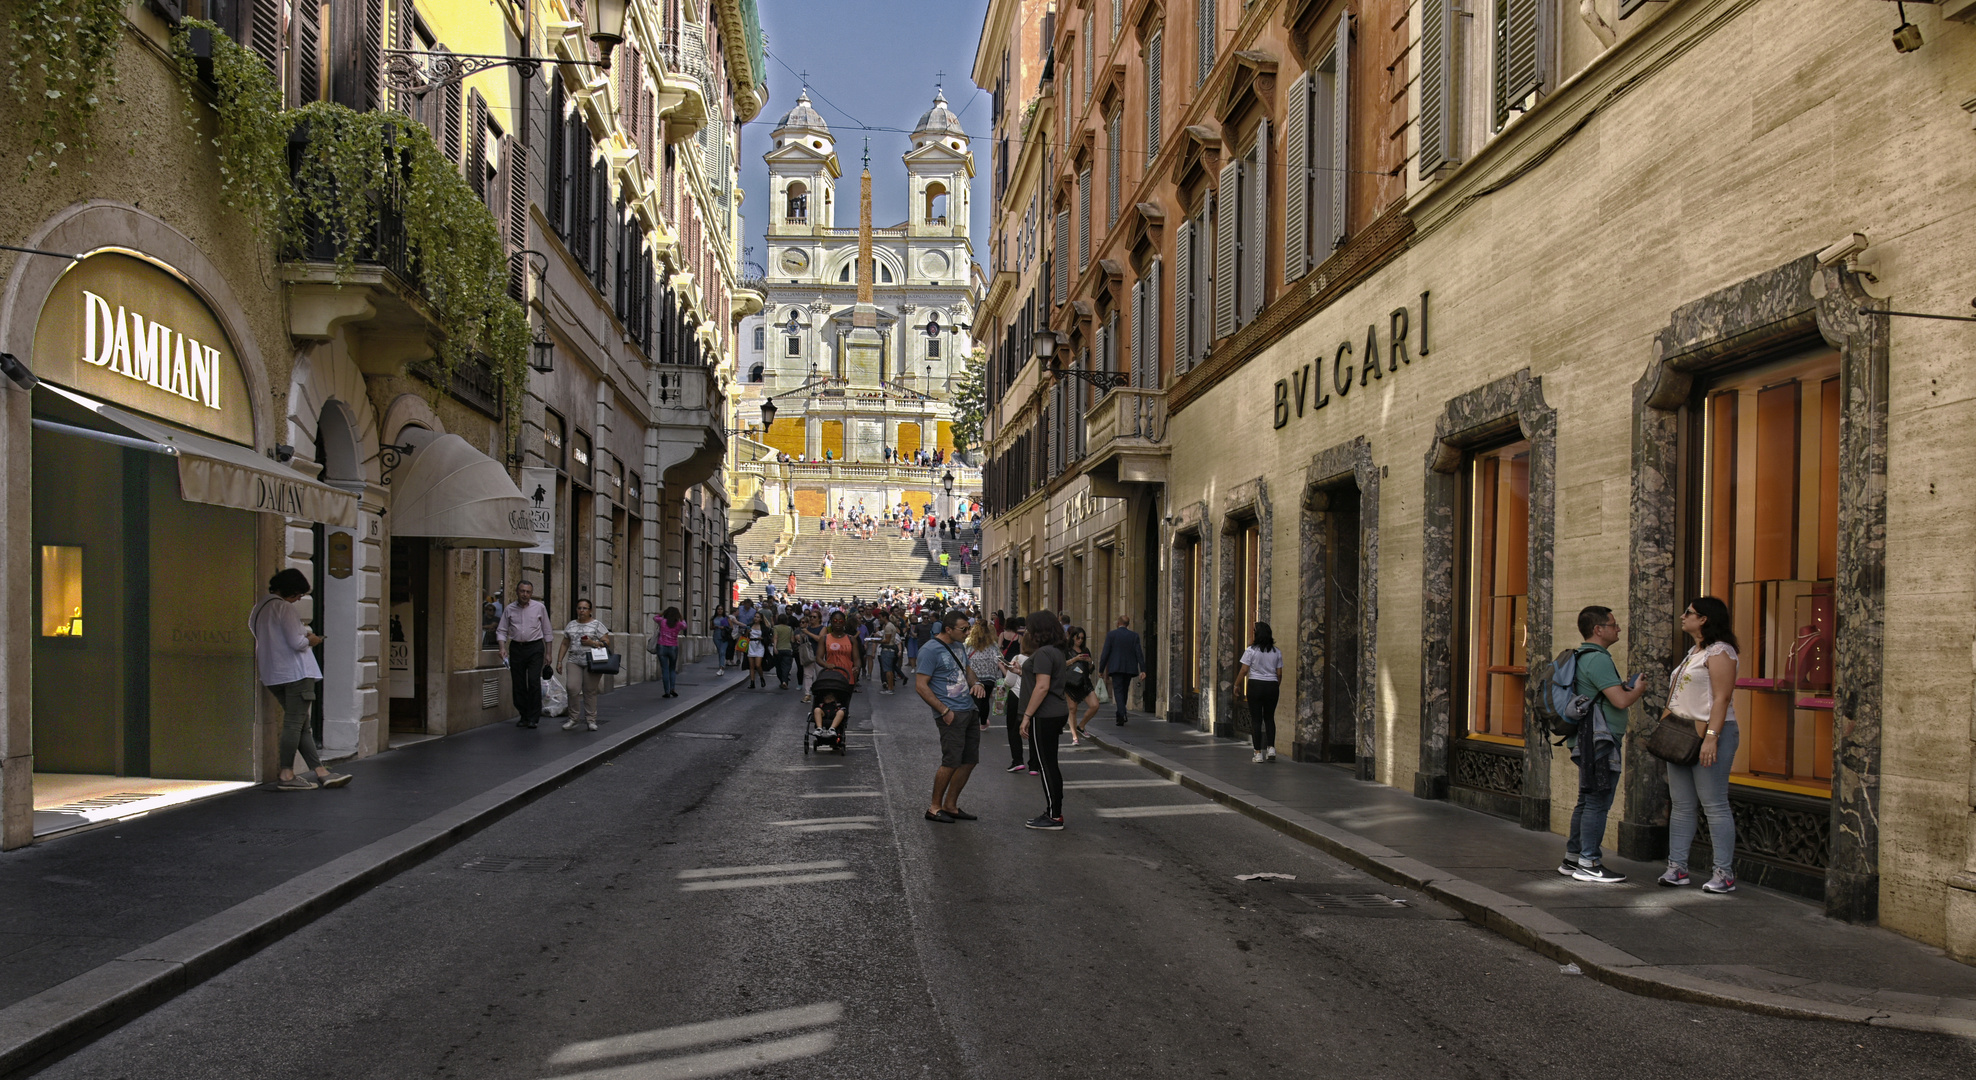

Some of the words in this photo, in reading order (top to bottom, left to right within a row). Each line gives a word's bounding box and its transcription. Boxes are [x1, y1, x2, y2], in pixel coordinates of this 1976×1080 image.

[82, 291, 221, 410] DAMIANI
[1273, 290, 1430, 430] BVLGARI
[390, 644, 408, 659] 50
[390, 658, 408, 666] NNI
